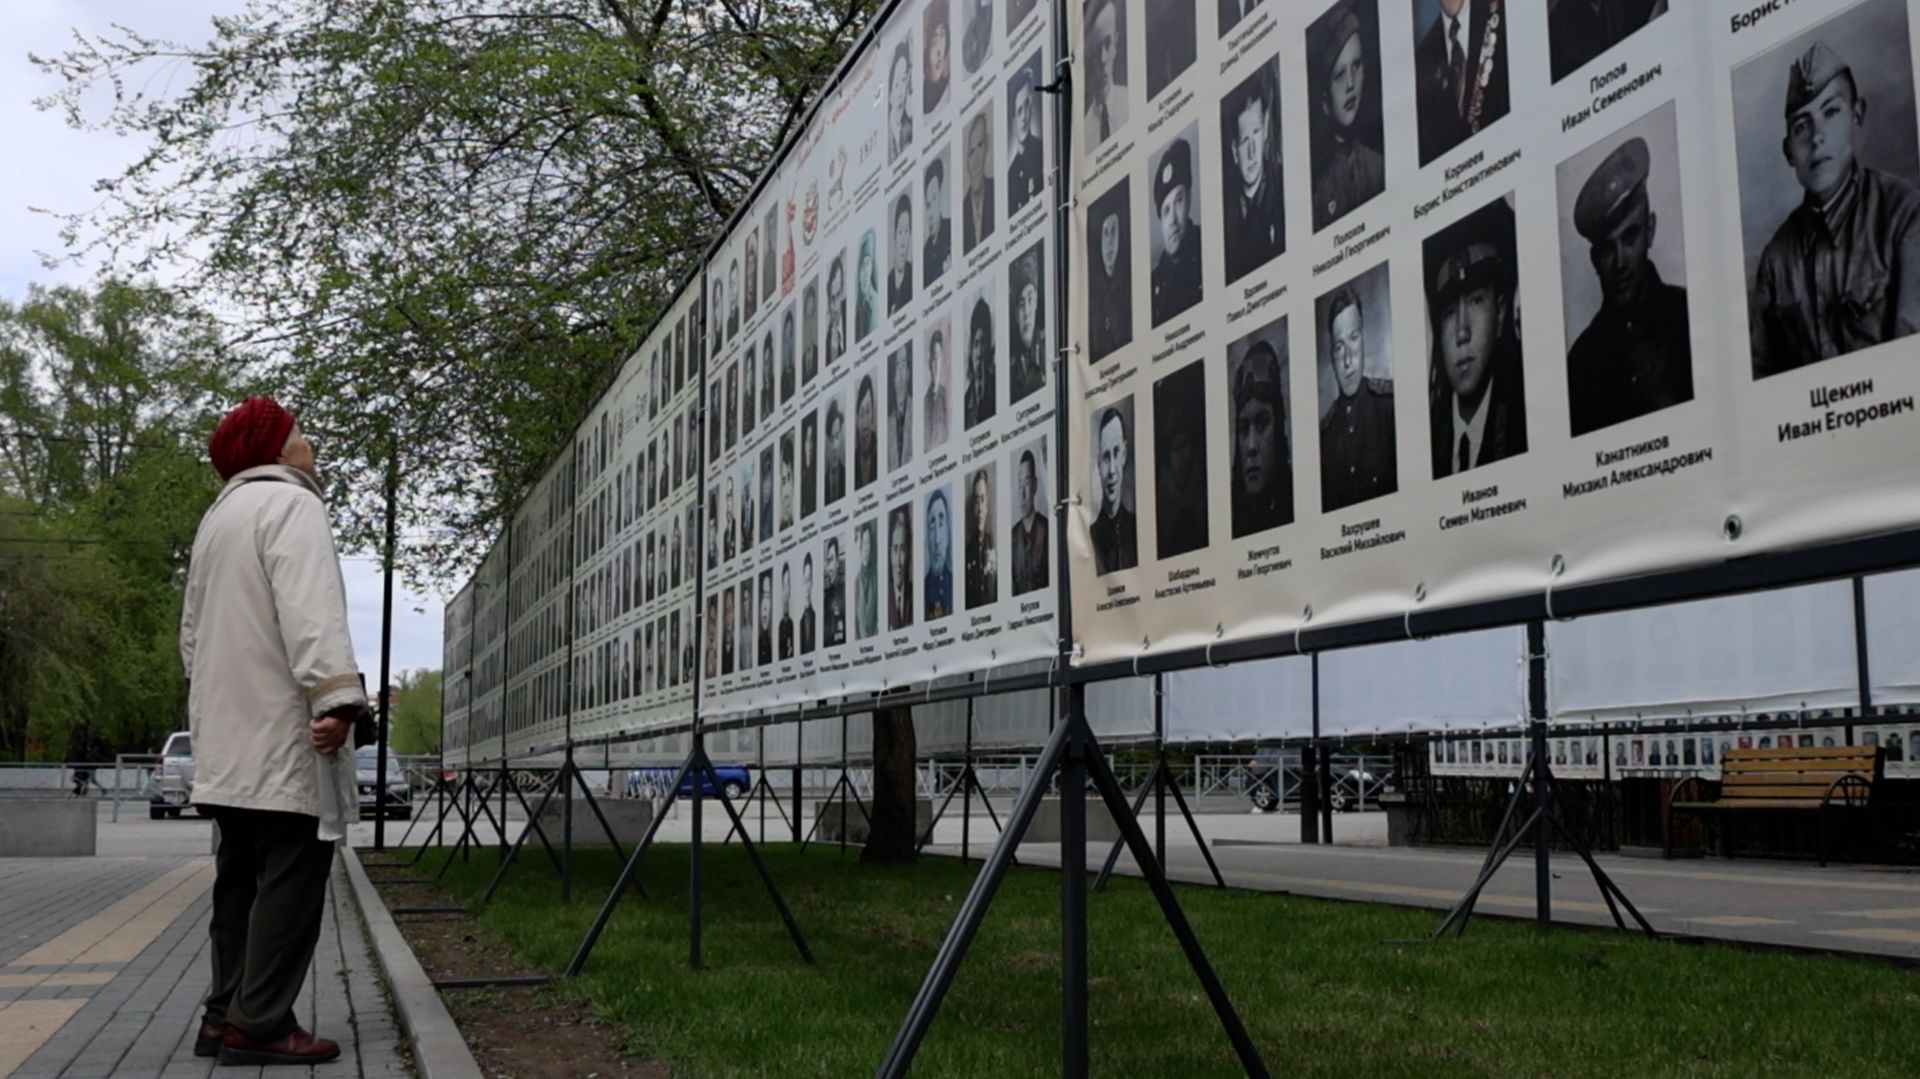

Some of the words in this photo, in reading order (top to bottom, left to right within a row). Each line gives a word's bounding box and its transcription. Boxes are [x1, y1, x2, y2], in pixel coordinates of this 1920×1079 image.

[1730, 0, 1781, 33] Борис
[1590, 62, 1627, 94] Попов
[1562, 107, 1591, 133] Иван
[1592, 64, 1662, 113] Семенович
[1445, 150, 1484, 181] Корнеев
[1414, 196, 1441, 219] Борис
[1442, 149, 1521, 202] Константинович
[1312, 249, 1344, 277] Николай
[1344, 225, 1391, 258] Георгиевич
[1810, 379, 1873, 408] Щекин
[1778, 420, 1822, 442] Иван
[1825, 396, 1914, 431] Егорович
[1595, 436, 1670, 468] Канатников
[1563, 475, 1608, 498] Михаил
[1610, 448, 1712, 487] Александрович
[1462, 485, 1498, 504] Иванов
[1341, 518, 1381, 537] Вахрушев
[1439, 514, 1469, 530] Семен
[1471, 498, 1526, 522] Матвеевич
[1320, 541, 1352, 560] Василий
[1354, 531, 1405, 552] Михайлович
